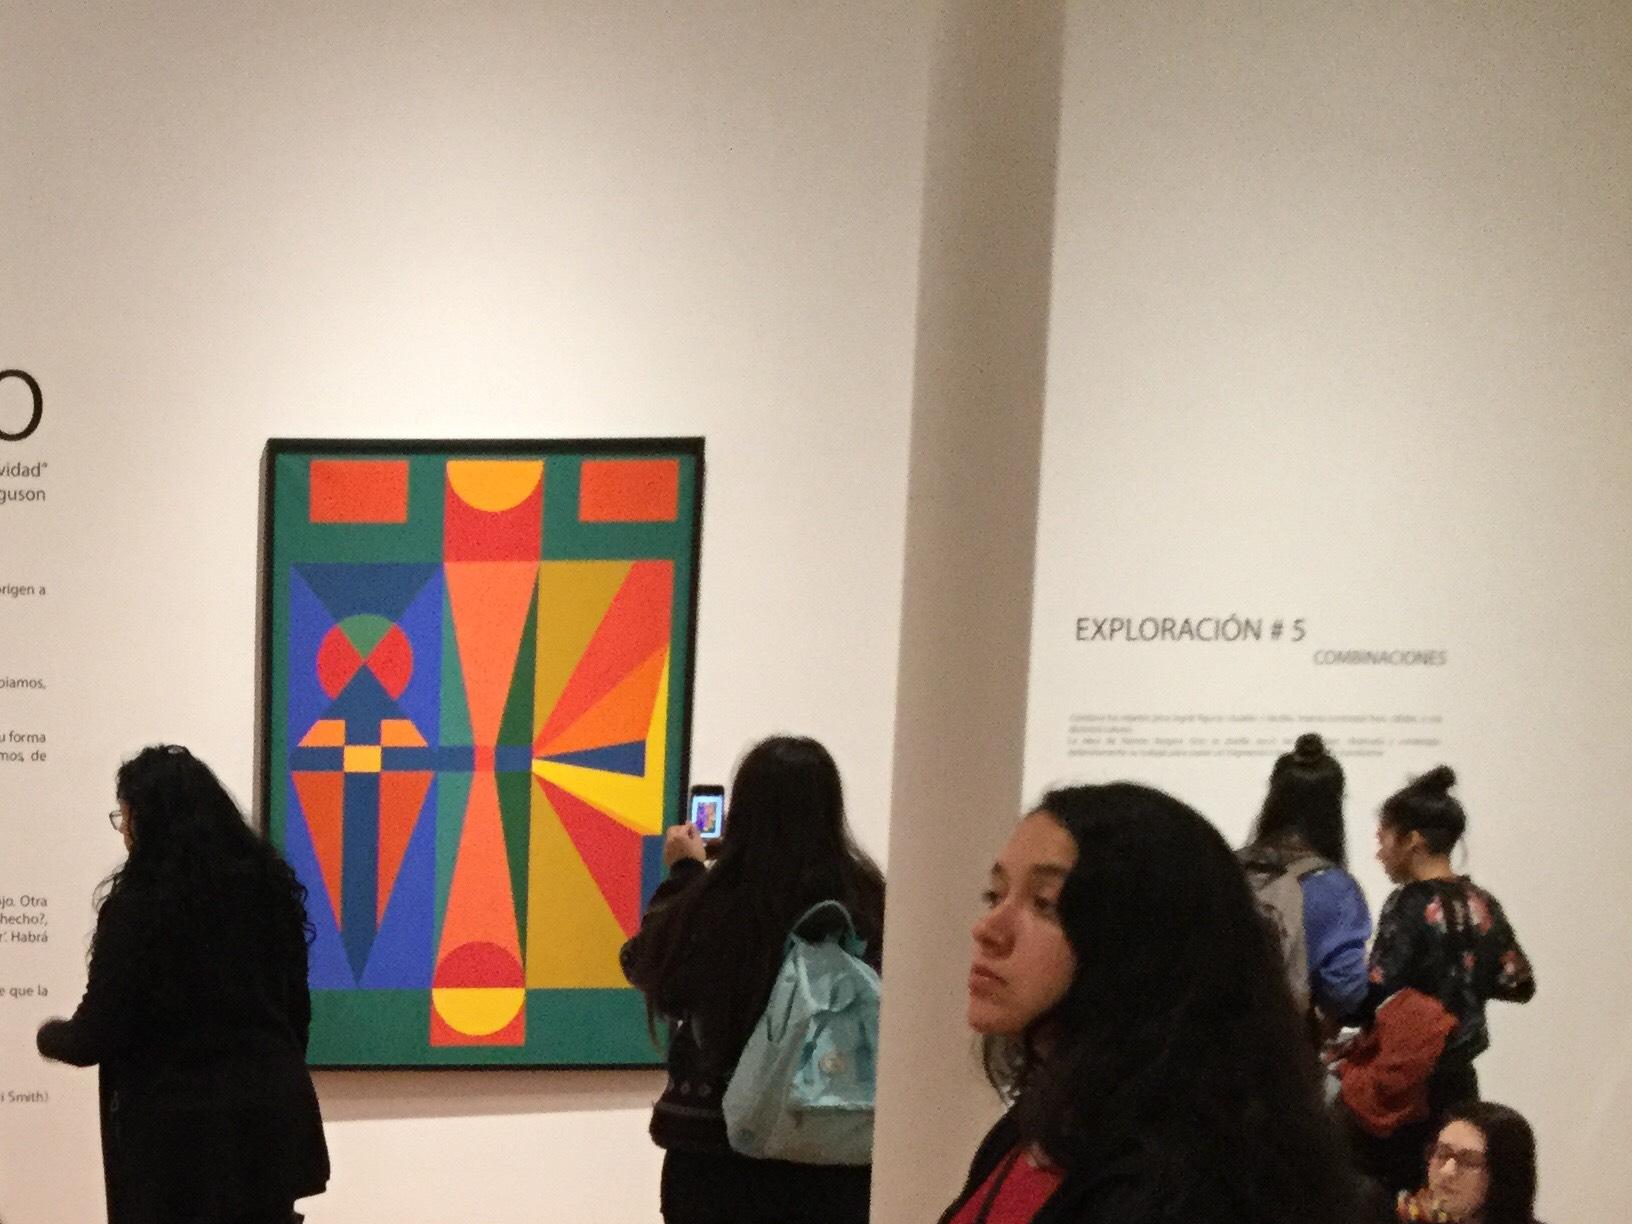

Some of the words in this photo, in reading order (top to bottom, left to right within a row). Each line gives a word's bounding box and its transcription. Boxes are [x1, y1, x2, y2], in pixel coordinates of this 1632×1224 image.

[1075, 613, 1262, 642] EXPLORACIÓN
[1270, 619, 1285, 641] #
[1292, 619, 1307, 642] 5
[1313, 649, 1448, 667] COMBINACIONES
[8, 730, 46, 743] forma
[19, 894, 48, 907] Otra
[0, 912, 48, 926] hecho?,
